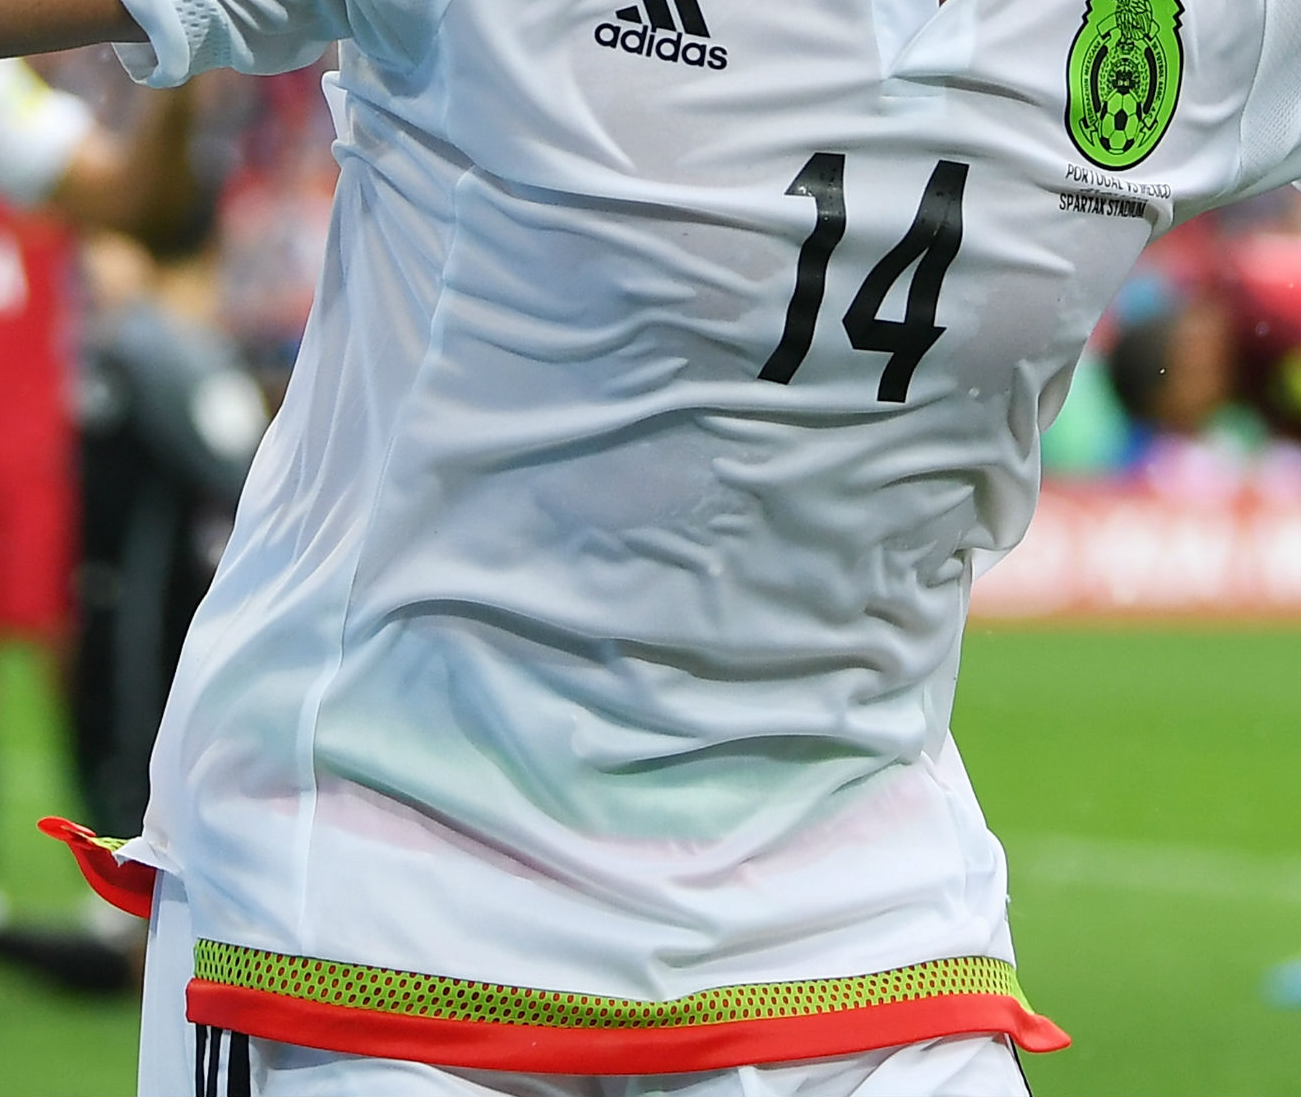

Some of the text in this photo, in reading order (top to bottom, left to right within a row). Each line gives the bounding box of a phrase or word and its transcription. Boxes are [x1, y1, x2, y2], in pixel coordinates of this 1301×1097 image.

[594, 22, 728, 70] adidas
[1059, 192, 1105, 215] SPARTAK
[756, 151, 970, 404] 14
